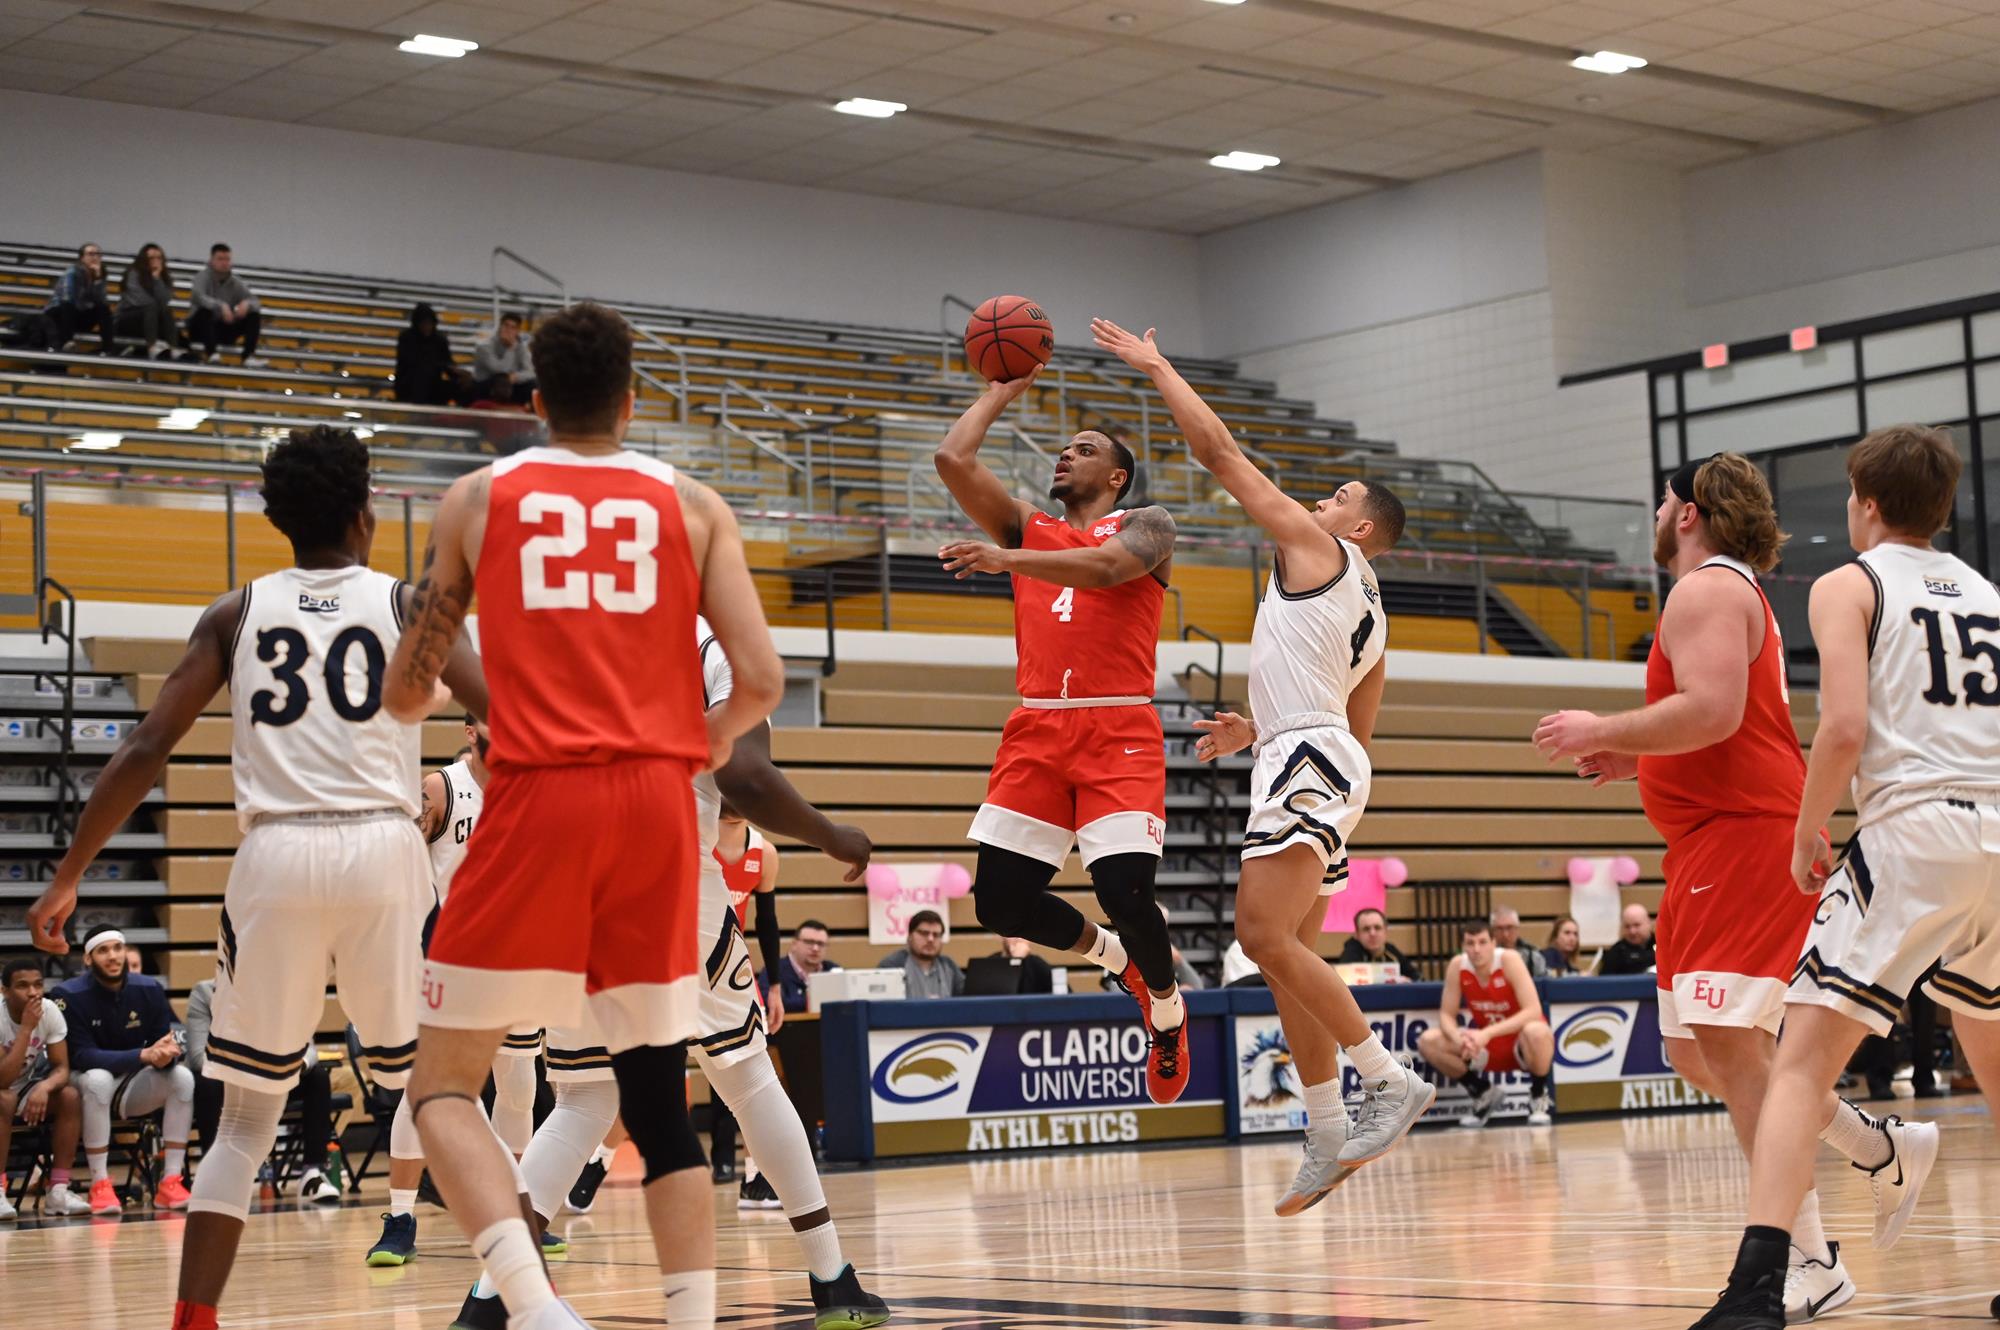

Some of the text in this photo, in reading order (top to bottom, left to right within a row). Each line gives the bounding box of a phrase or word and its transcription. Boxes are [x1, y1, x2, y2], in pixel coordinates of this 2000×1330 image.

[519, 491, 659, 614] 23
[1051, 587, 1074, 622] 4
[1924, 579, 1961, 593] PSAC
[250, 626, 387, 727] 30
[1910, 607, 2000, 708] 15
[1147, 817, 1162, 845] EU
[1693, 979, 1726, 1009] EU
[1018, 1026, 1153, 1067] CLARIO
[967, 1111, 1139, 1150] ATHLETICS
